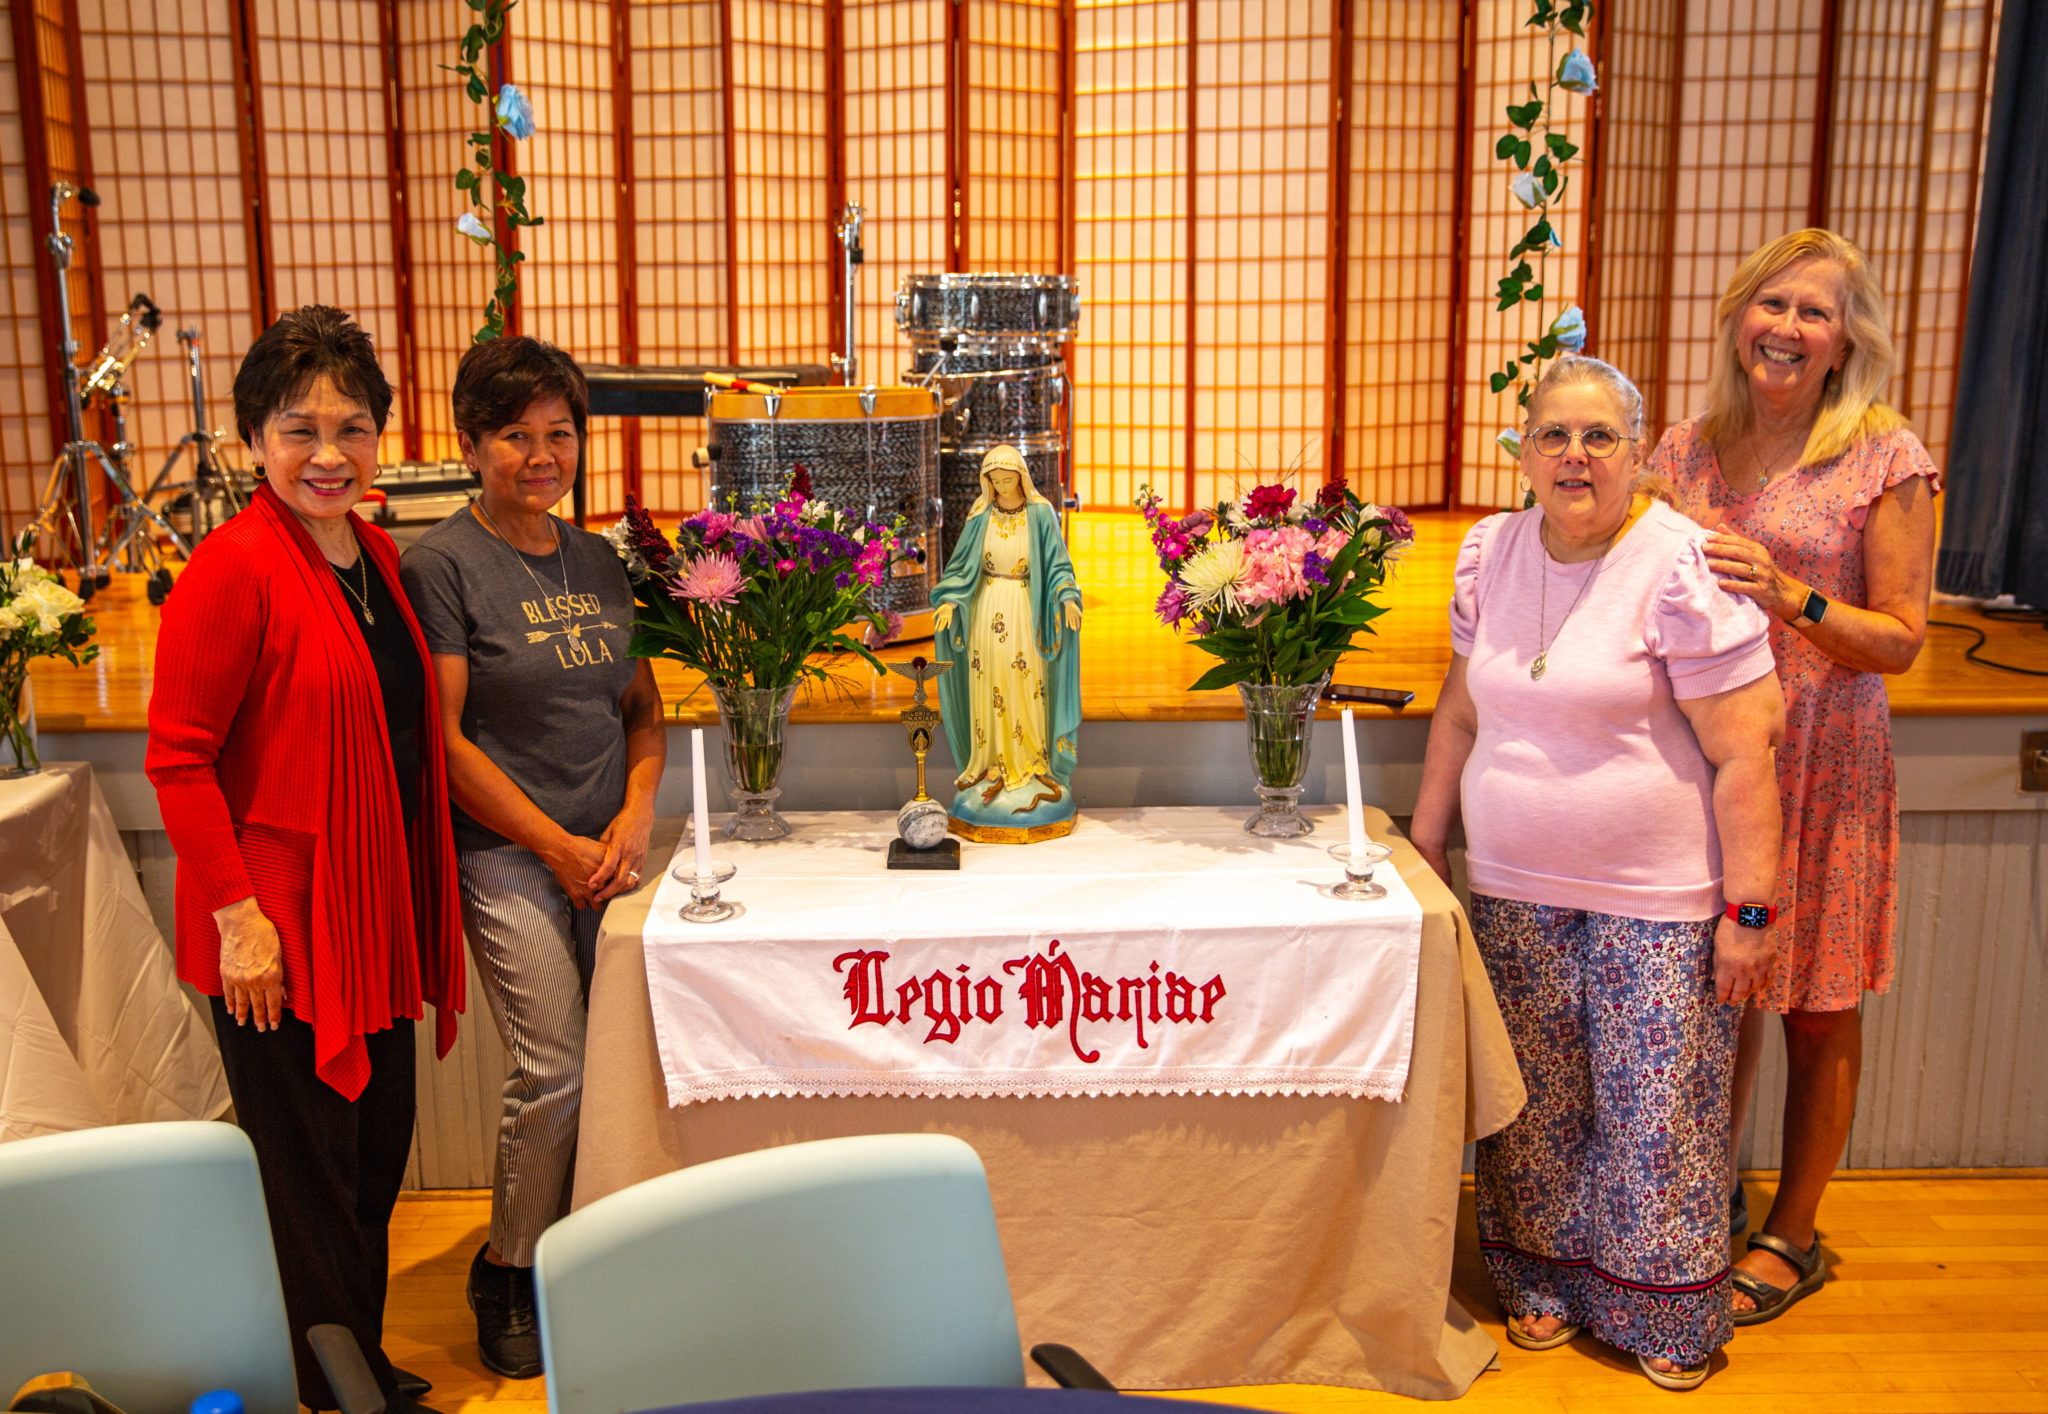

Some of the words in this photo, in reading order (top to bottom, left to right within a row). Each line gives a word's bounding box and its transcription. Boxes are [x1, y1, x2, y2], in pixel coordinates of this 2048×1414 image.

[522, 593, 601, 624] BLESSED
[555, 638, 614, 669] LOLA
[833, 949, 1003, 1044] Legio
[1003, 940, 1226, 1063] Mariae
